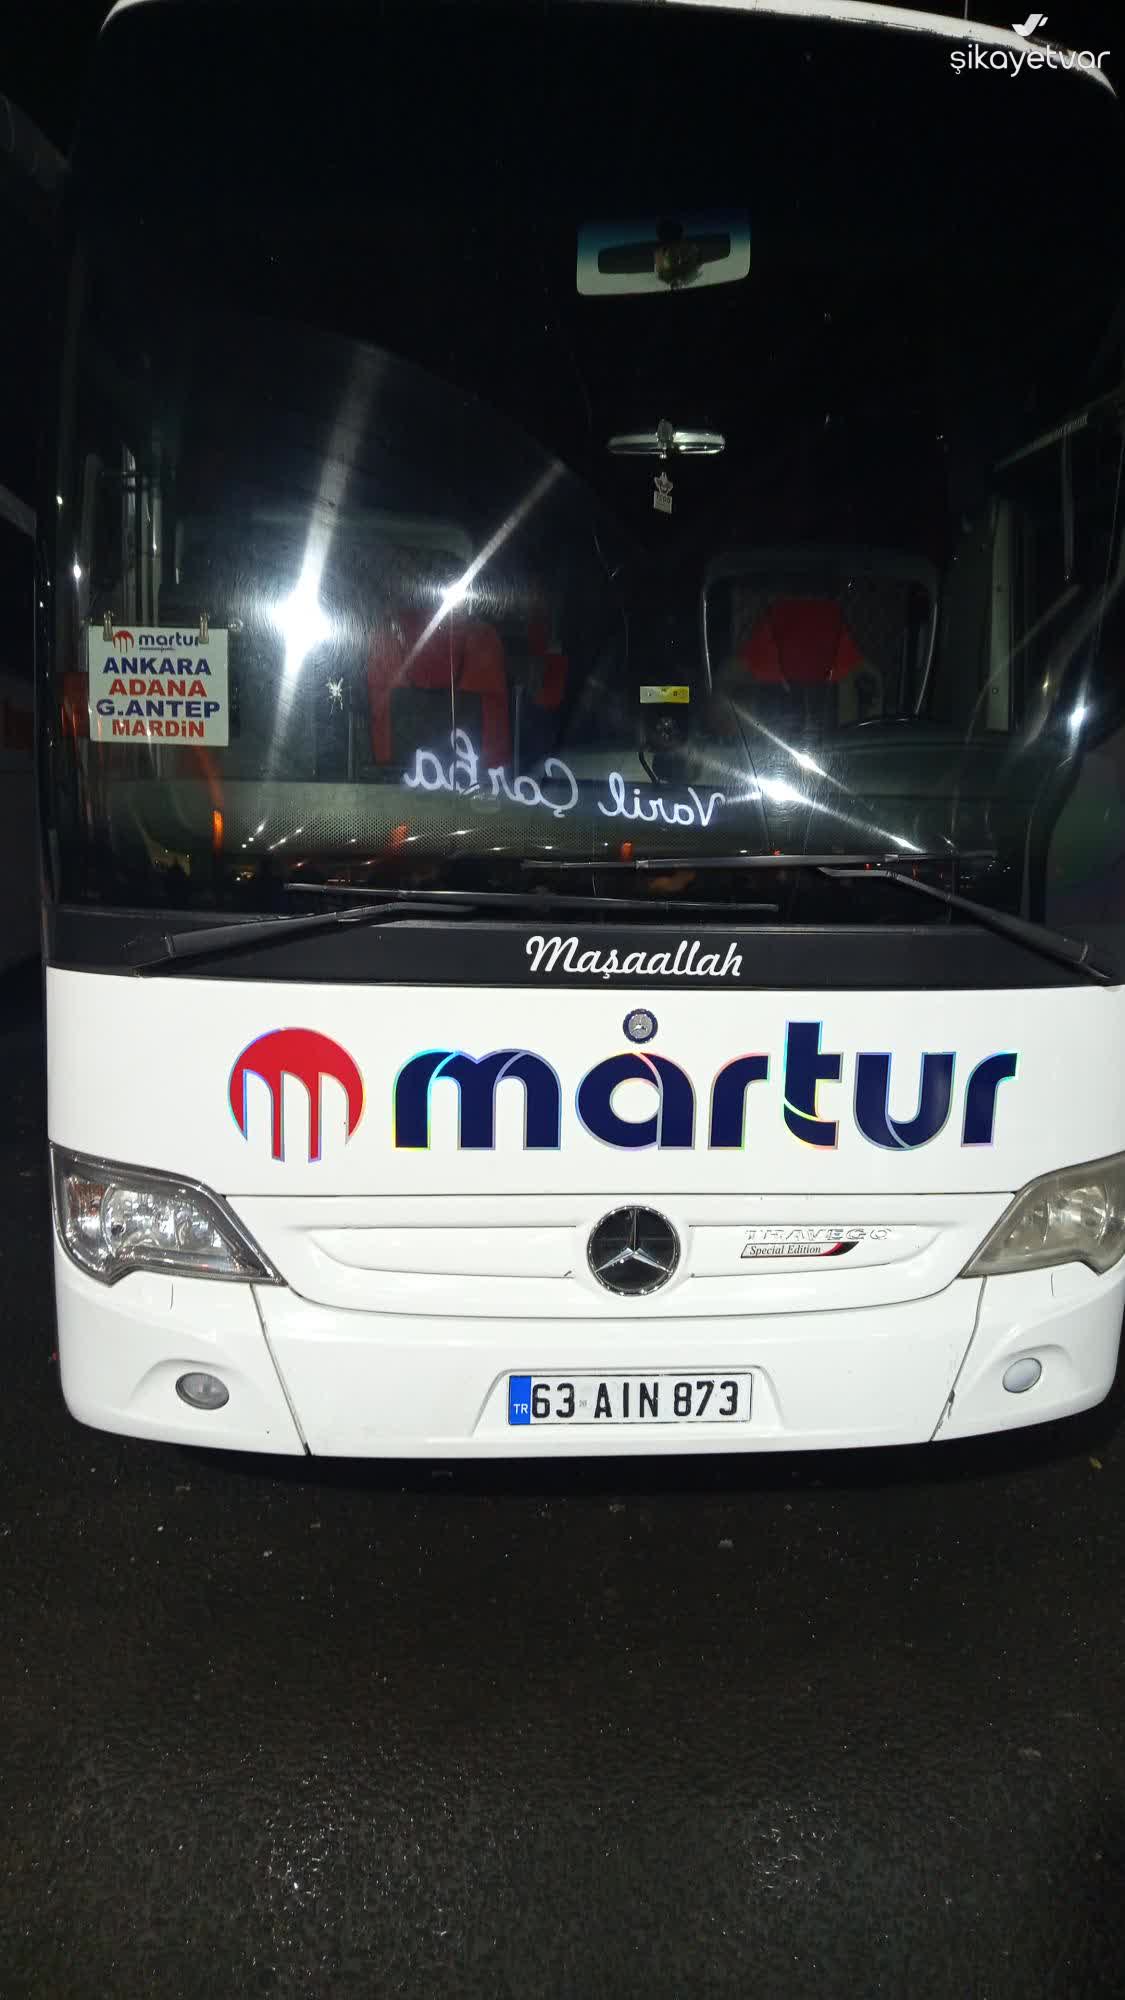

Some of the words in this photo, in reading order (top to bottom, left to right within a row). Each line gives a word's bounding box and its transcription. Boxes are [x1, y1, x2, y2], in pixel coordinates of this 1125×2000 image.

[103, 657, 212, 675] ANKARA
[109, 678, 208, 698] ADANA
[96, 699, 221, 718] G.ANTEP
[525, 935, 744, 979] Maşaallah
[393, 1020, 1020, 1151] martur
[744, 1228, 892, 1241] TRAVEGO
[749, 1244, 785, 1257] Special
[787, 1244, 822, 1255] Edition
[513, 1403, 528, 1415] TR
[531, 1382, 575, 1419] 63
[593, 1382, 659, 1419] AIN
[673, 1380, 739, 1417] 873
